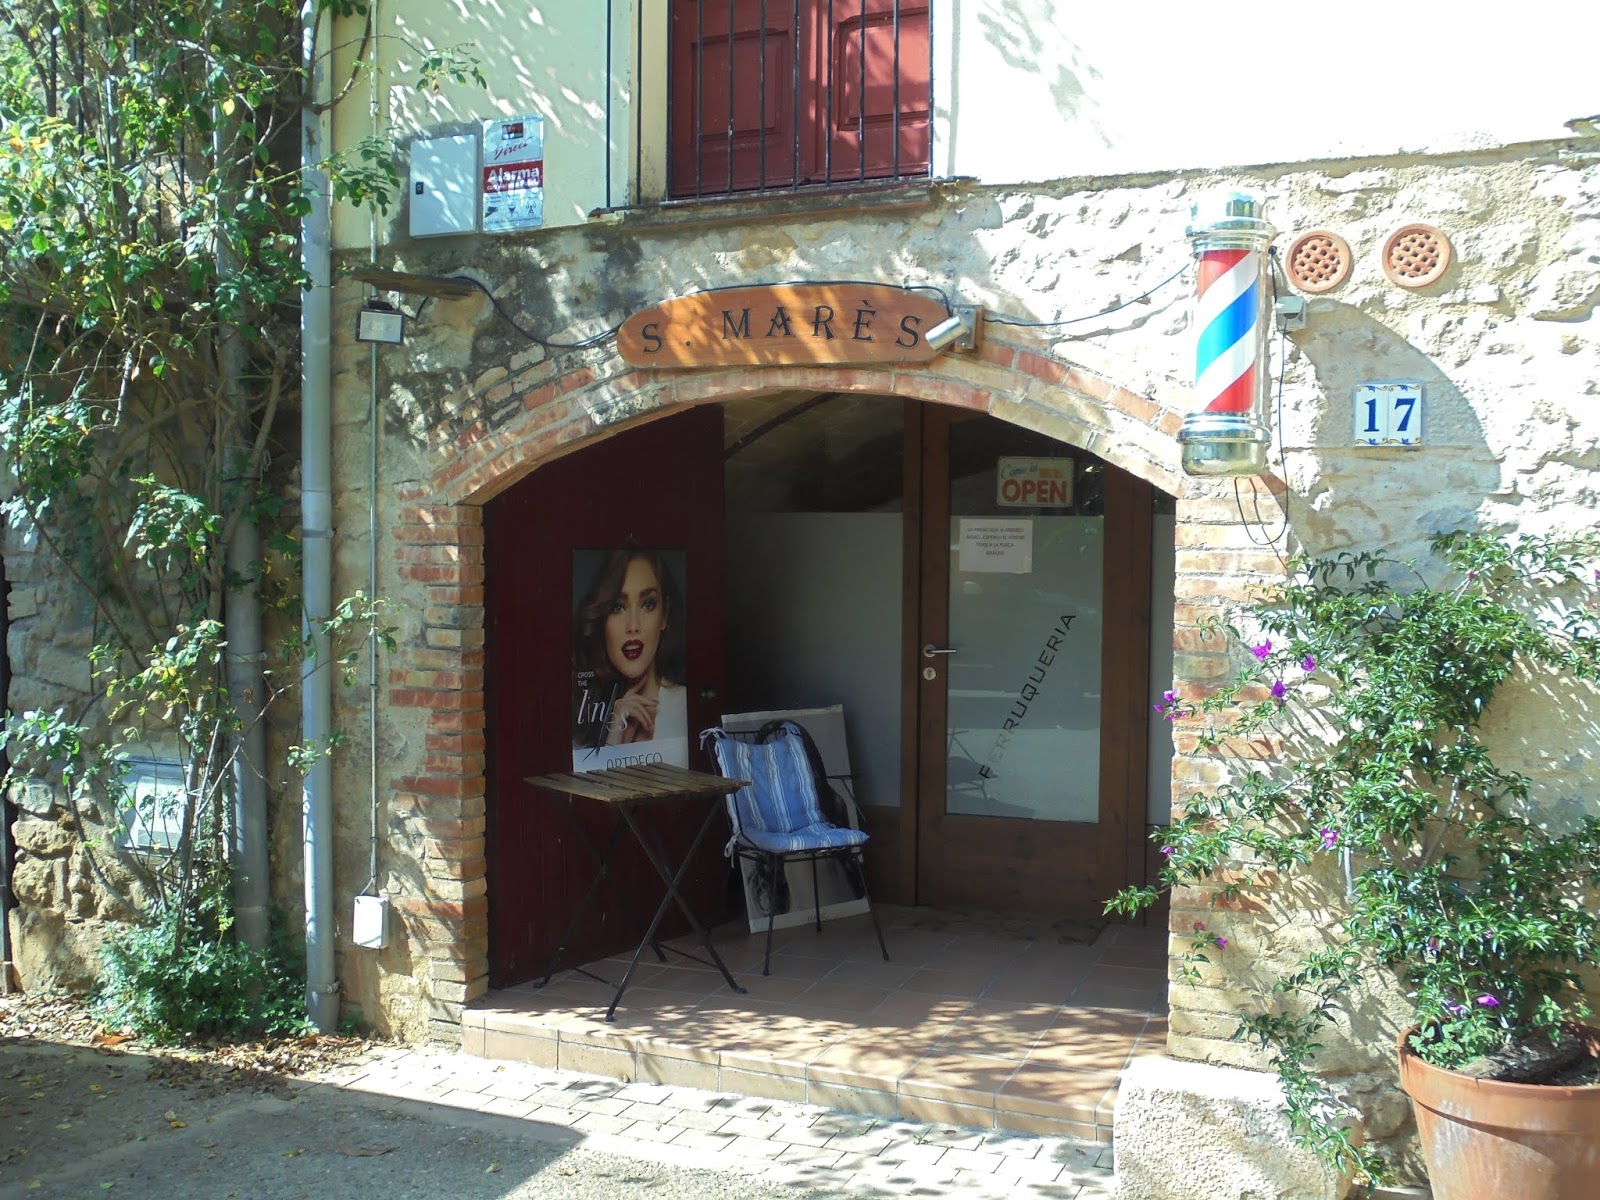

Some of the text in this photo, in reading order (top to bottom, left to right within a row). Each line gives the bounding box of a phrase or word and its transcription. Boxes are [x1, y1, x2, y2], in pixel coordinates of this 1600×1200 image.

[487, 167, 540, 184] Alarma
[721, 299, 922, 349] MARÈS
[1364, 398, 1416, 432] 17
[1002, 479, 1067, 503] OPEN
[577, 671, 595, 679] CROSS
[577, 689, 630, 733] lines
